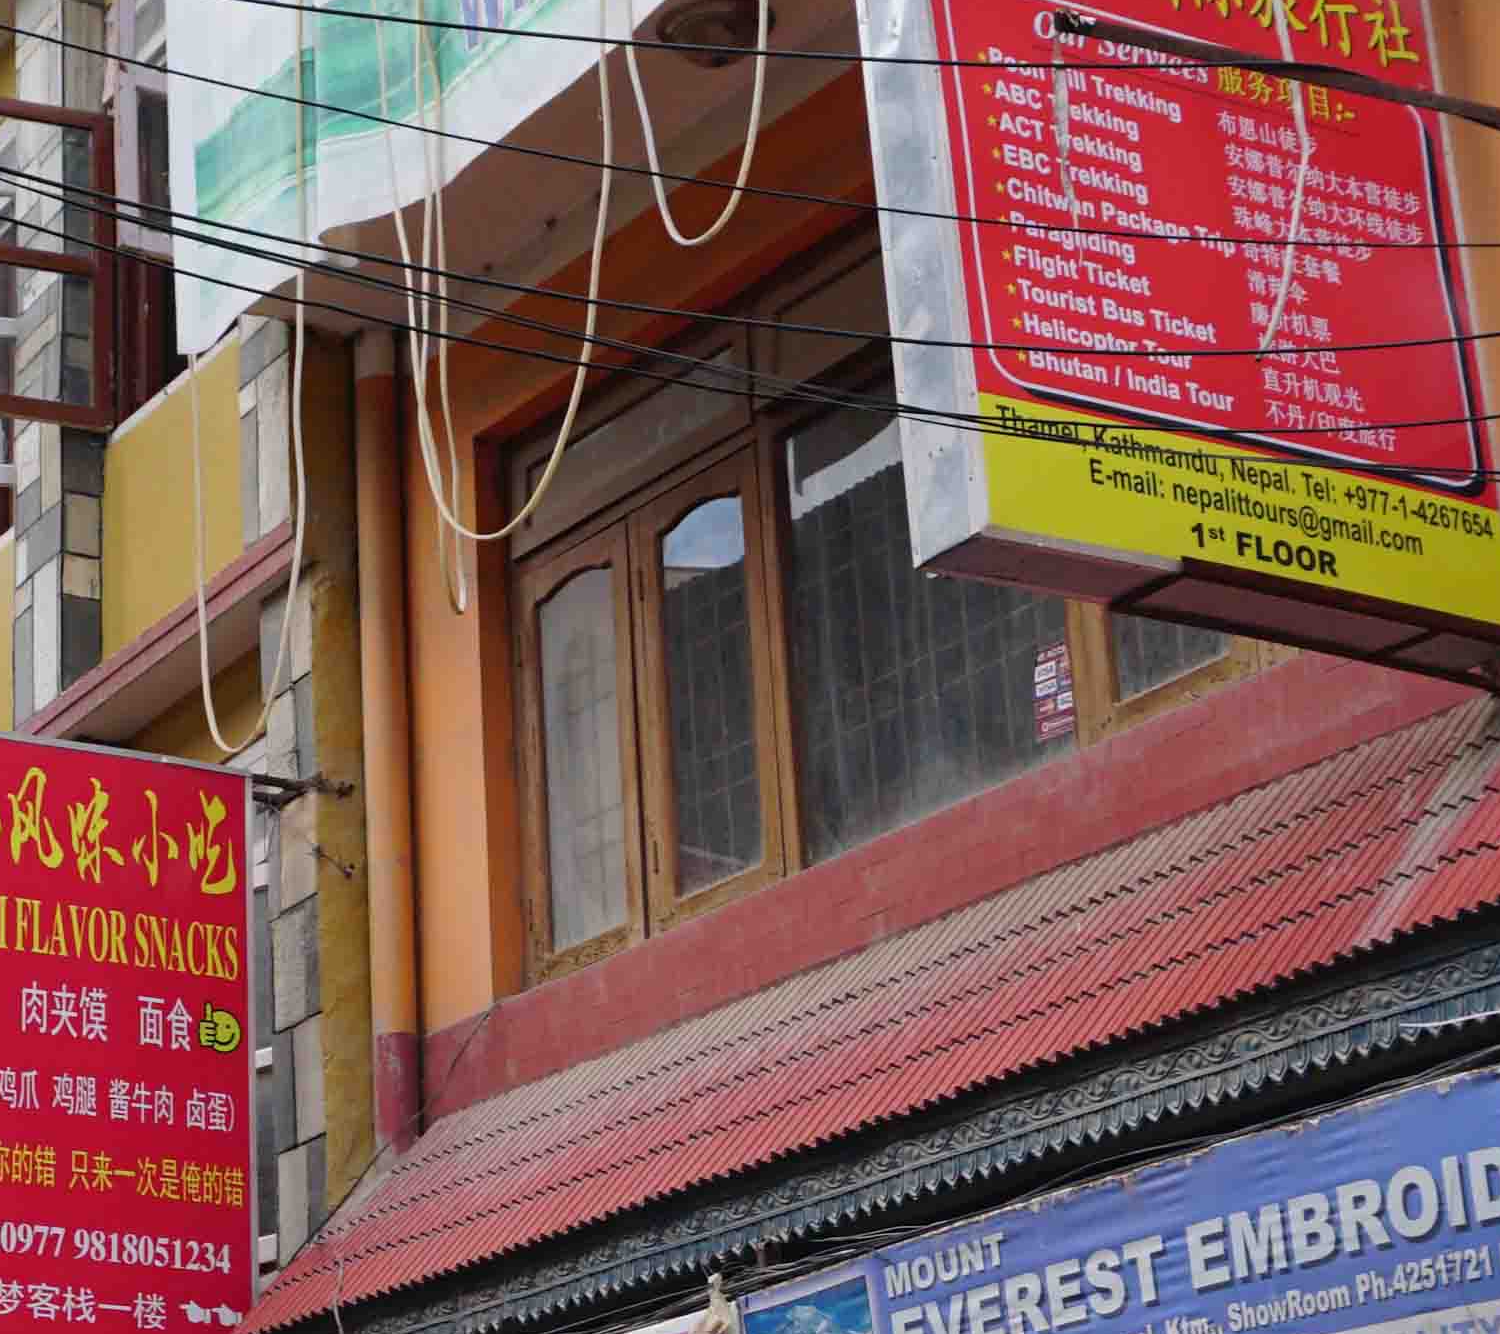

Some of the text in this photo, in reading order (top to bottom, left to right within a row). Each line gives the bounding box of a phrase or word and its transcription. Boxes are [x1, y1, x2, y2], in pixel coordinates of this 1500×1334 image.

[995, 80, 1043, 110] ABC
[1091, 75, 1182, 123] Trekking
[999, 112, 1044, 140] ACT
[1003, 143, 1052, 174] EBC
[1013, 244, 1151, 296] Flight Ticket
[1016, 278, 1217, 344] Tourist Bus Ticket
[1029, 349, 1234, 412] Bhutan India Tour
[1089, 457, 1166, 500] E-mail:
[1301, 472, 1338, 505] Tel:
[1343, 485, 1496, 540] +977-1-4267654
[1235, 531, 1339, 577] FLOOR
[15, 896, 127, 966] FLAVOR
[134, 921, 239, 982] SNACKS
[21, 982, 109, 1043] 肉夹馍
[137, 996, 194, 1053] 面食
[68, 1154, 246, 1210] 只来一次是俺的错
[72, 1228, 232, 1275] 9818051234
[884, 1232, 1007, 1301] MOUNT
